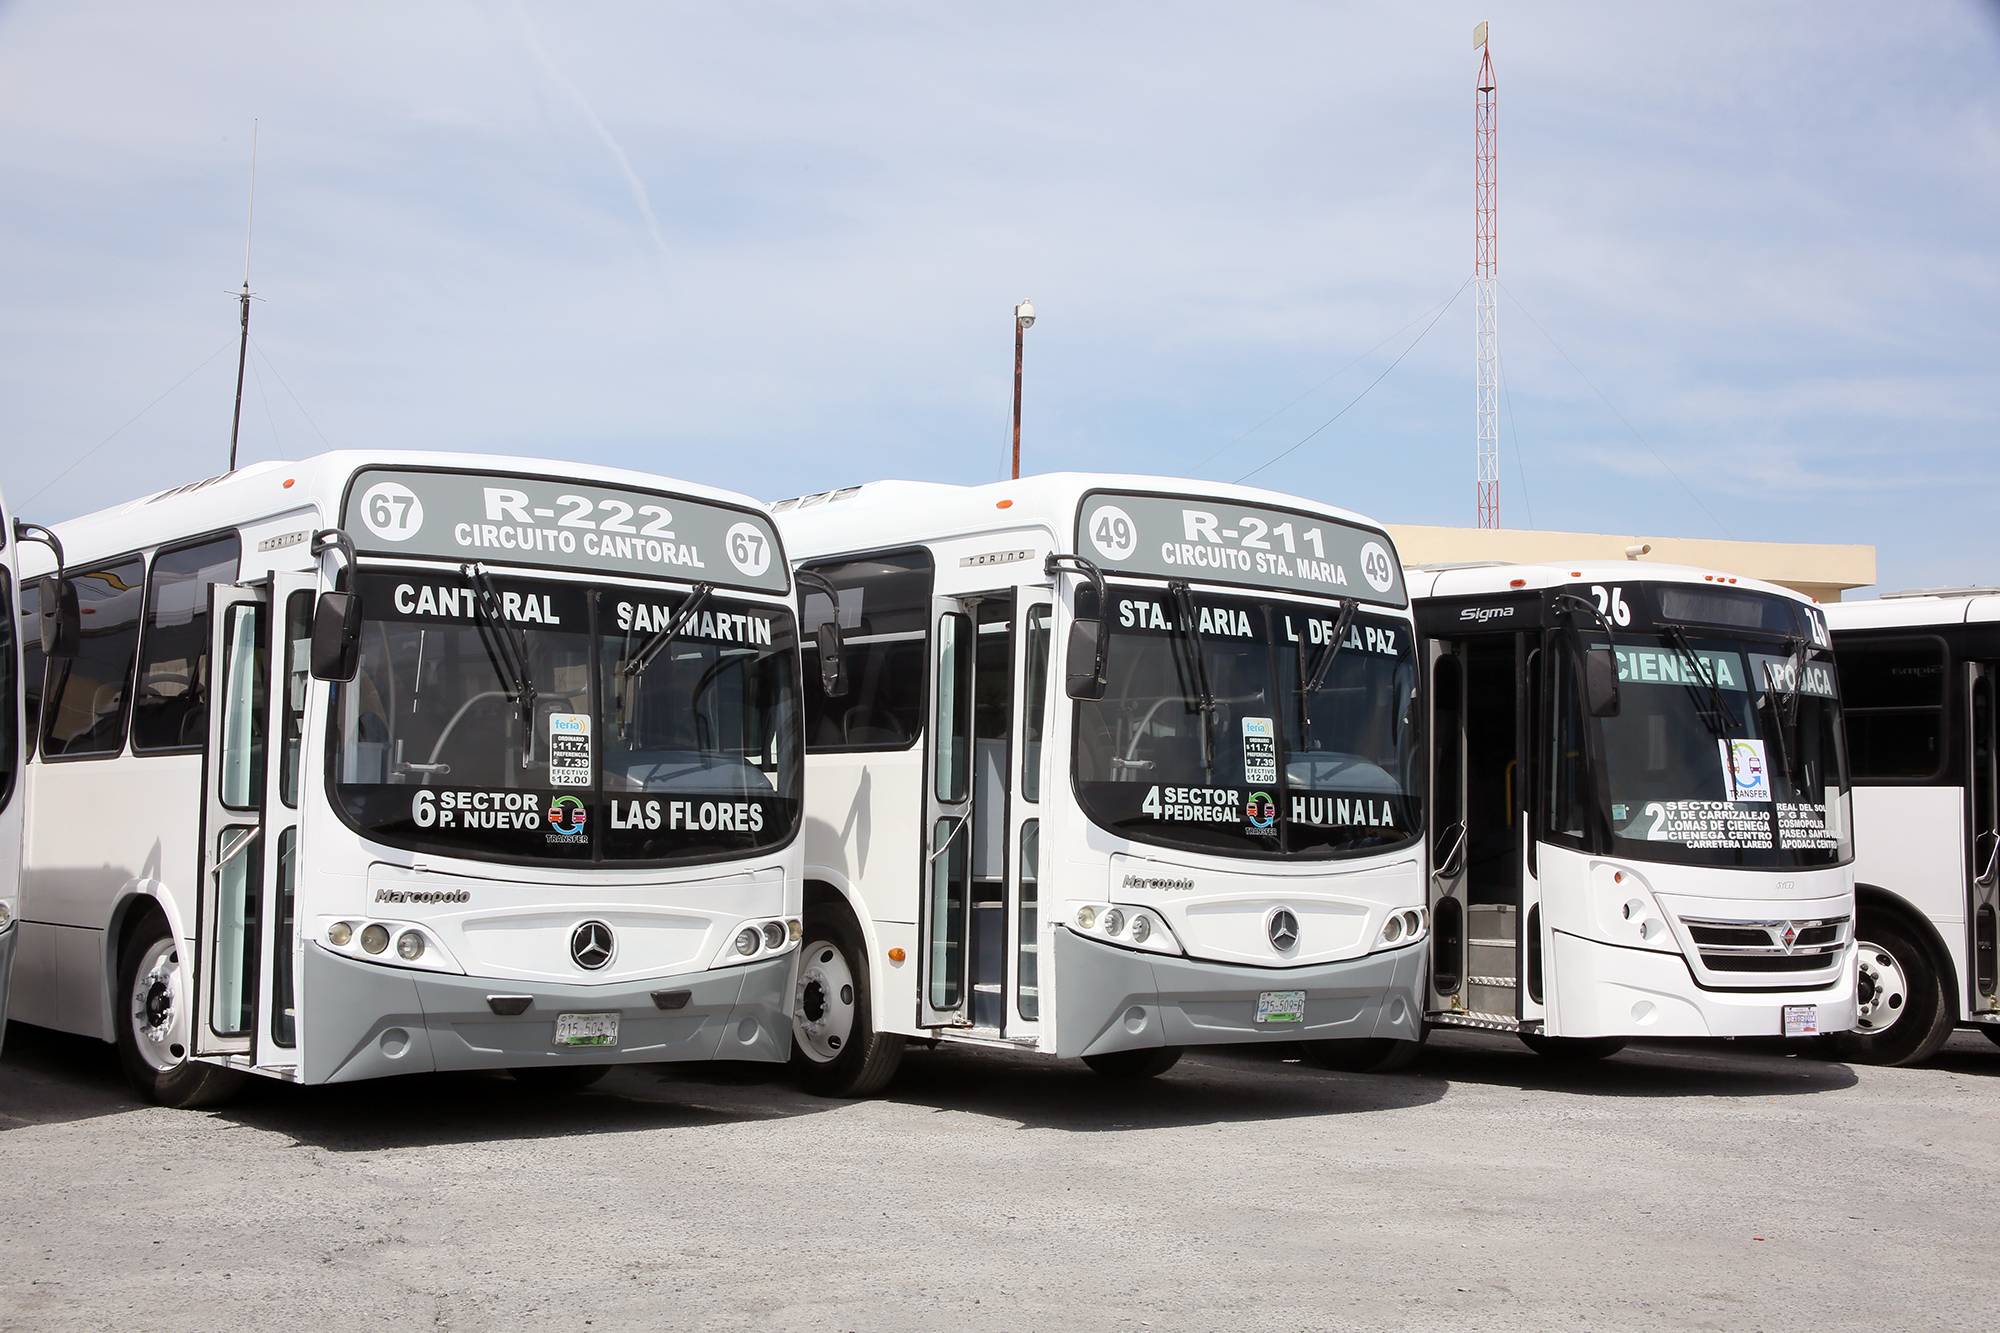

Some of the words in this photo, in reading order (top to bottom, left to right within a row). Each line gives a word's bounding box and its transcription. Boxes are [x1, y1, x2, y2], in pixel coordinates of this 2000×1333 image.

[369, 493, 415, 529] 67
[483, 487, 676, 540] R-222
[454, 522, 576, 554] CIRCUITO
[583, 532, 705, 568] CANTORAL
[1096, 516, 1130, 549] 49
[1182, 509, 1325, 559] R-211
[731, 531, 765, 567] 67
[969, 551, 1025, 565] TORINO
[1161, 542, 1251, 571] CIRCUITO
[1256, 552, 1294, 577] STA.
[1296, 558, 1348, 586] MARIA
[1365, 551, 1389, 583] 49
[394, 583, 560, 625] CANTRAL
[1119, 600, 1173, 631] STA.
[1460, 607, 1514, 623] Sigma
[1591, 585, 1631, 627] 26
[616, 601, 670, 634] SAN
[679, 610, 771, 646] MARTIN
[1804, 607, 1827, 648] 26
[1308, 618, 1333, 646] DE
[1365, 626, 1398, 656] PAZ
[440, 791, 539, 811] SECTOR
[1142, 785, 1162, 819] 4
[1164, 787, 1239, 806] SECTOR
[1666, 801, 1735, 811] SECTOR
[1729, 789, 1768, 798] TRANSFER
[412, 790, 436, 828] 6
[440, 810, 456, 828] P.
[464, 811, 540, 830] NUEVO
[611, 800, 661, 830] LAS
[669, 802, 763, 832] FLORES
[1164, 804, 1241, 823] PEDREGAL
[1292, 796, 1394, 827] HUINALA
[1666, 810, 1678, 820] V.
[1681, 810, 1697, 820] DE
[1699, 810, 1771, 821] CARRIZALEJO
[1776, 803, 1798, 811] REAL
[1799, 803, 1813, 812] DEL
[1645, 802, 1668, 841] 2
[1668, 820, 1708, 831] LOMAS
[1710, 820, 1725, 831] DE
[1727, 820, 1771, 832] CIENEGA
[1778, 820, 1825, 829] COSMOPOLIS
[1780, 829, 1807, 839] PASEO
[1808, 829, 1830, 839] SANTA
[545, 834, 589, 844] TRANSFER
[1668, 831, 1726, 840] CIENEGA
[1728, 831, 1773, 841] CENTRO
[1686, 840, 1740, 849] CARRETERA
[1742, 840, 1773, 849] LAREDO
[1781, 840, 1816, 849] APODACA
[1816, 840, 1838, 849] CENTRO
[1122, 874, 1195, 891] Marcopolo
[374, 889, 471, 904] Marcopolo
